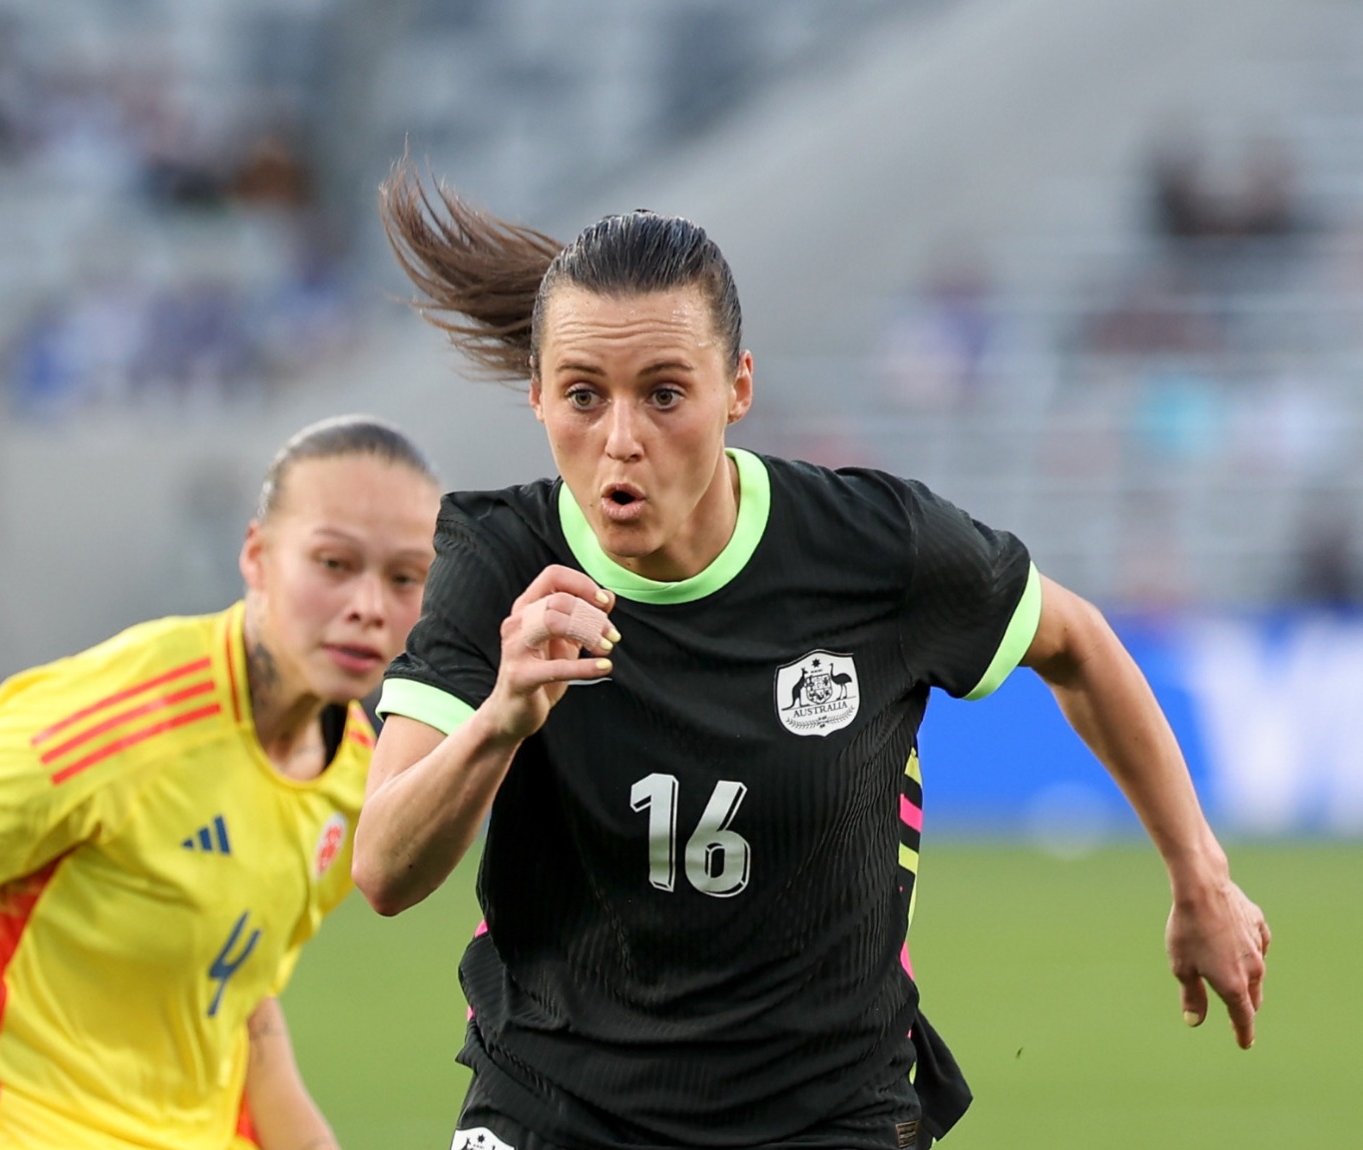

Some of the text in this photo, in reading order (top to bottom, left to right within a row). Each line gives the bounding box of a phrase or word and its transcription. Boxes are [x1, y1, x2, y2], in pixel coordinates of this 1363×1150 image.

[793, 701, 848, 718] AUSTRALIA
[630, 773, 751, 898] 16
[205, 909, 263, 1018] 4
